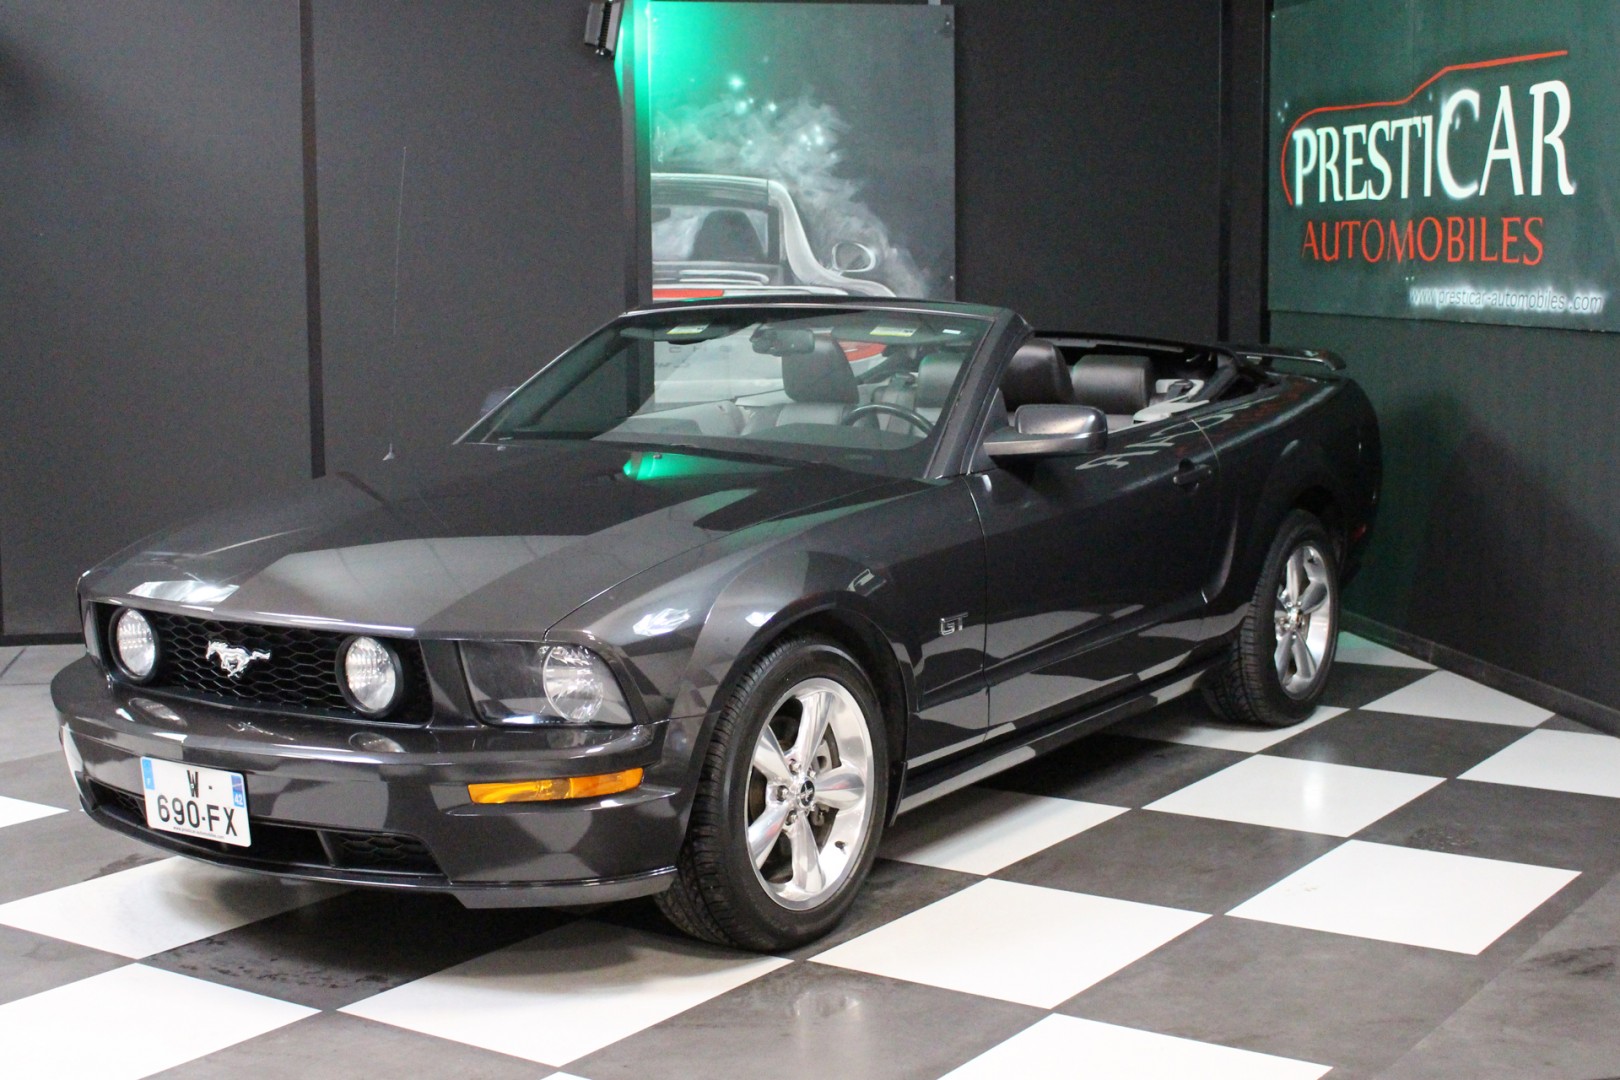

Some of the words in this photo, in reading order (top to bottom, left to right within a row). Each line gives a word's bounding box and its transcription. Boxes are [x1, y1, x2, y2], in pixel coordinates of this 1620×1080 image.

[1292, 80, 1577, 206] PRESTICAR
[1302, 216, 1544, 265] AUTOMOBILES
[940, 612, 969, 636] GT
